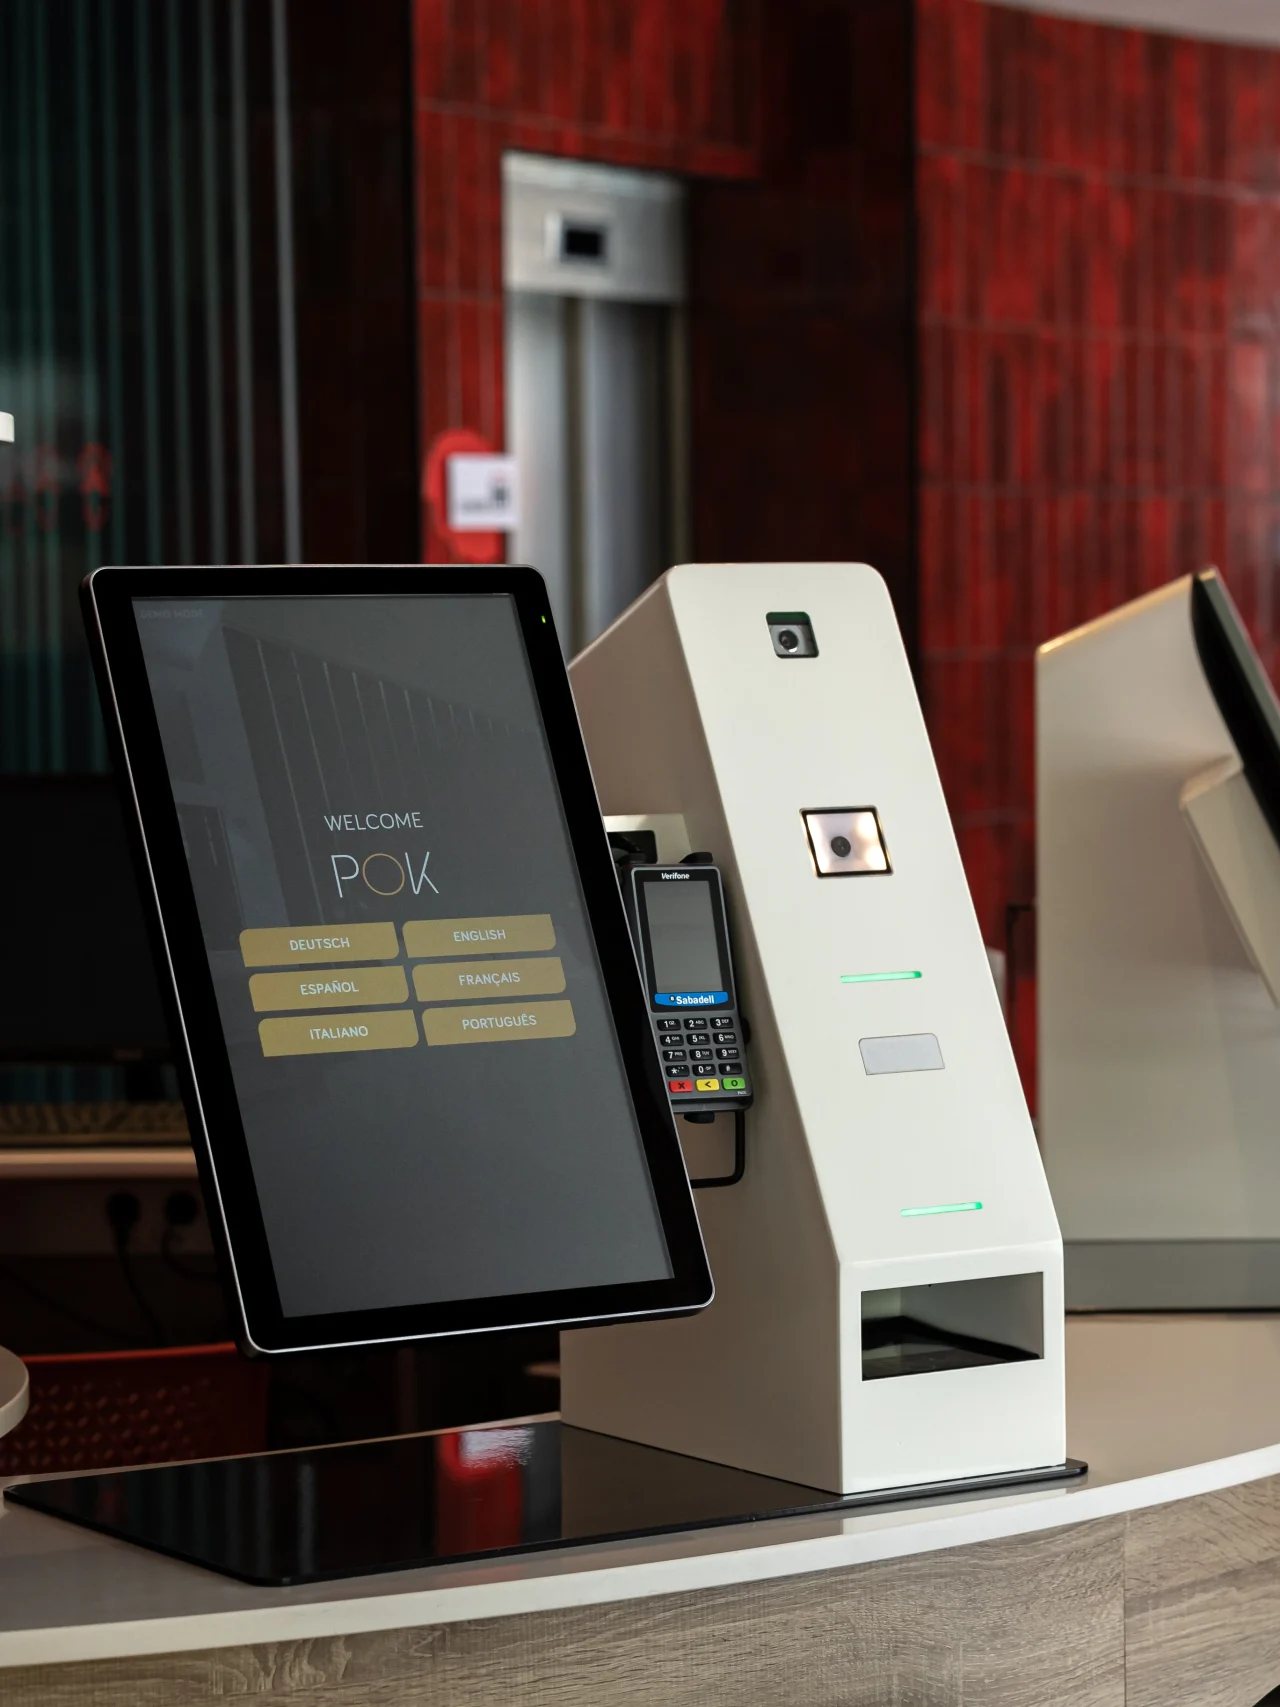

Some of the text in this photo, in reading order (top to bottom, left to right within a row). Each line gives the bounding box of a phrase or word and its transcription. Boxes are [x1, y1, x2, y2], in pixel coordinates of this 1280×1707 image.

[140, 608, 204, 619] DEMO MODE
[323, 811, 424, 832] WELCOME
[331, 850, 440, 898] POK
[661, 872, 690, 880] Verifone
[453, 929, 506, 943] ENGLISH
[289, 936, 350, 952] DEUTSCH
[458, 971, 521, 987] FRANÇAIS
[300, 979, 359, 996] ESPAÑOL
[676, 994, 715, 1005] Sabadell
[461, 1013, 538, 1030] PORTUGUÊS
[663, 1020, 669, 1028] 1
[688, 1019, 695, 1028] 2
[715, 1018, 721, 1026] 3
[309, 1025, 369, 1040] ITALIANO
[665, 1036, 671, 1044] 4
[692, 1034, 698, 1043] 5
[718, 1034, 724, 1042] 6
[668, 1051, 674, 1059] 7
[695, 1050, 702, 1058] 8
[722, 1049, 728, 1057] 9
[698, 1066, 704, 1074] 0
